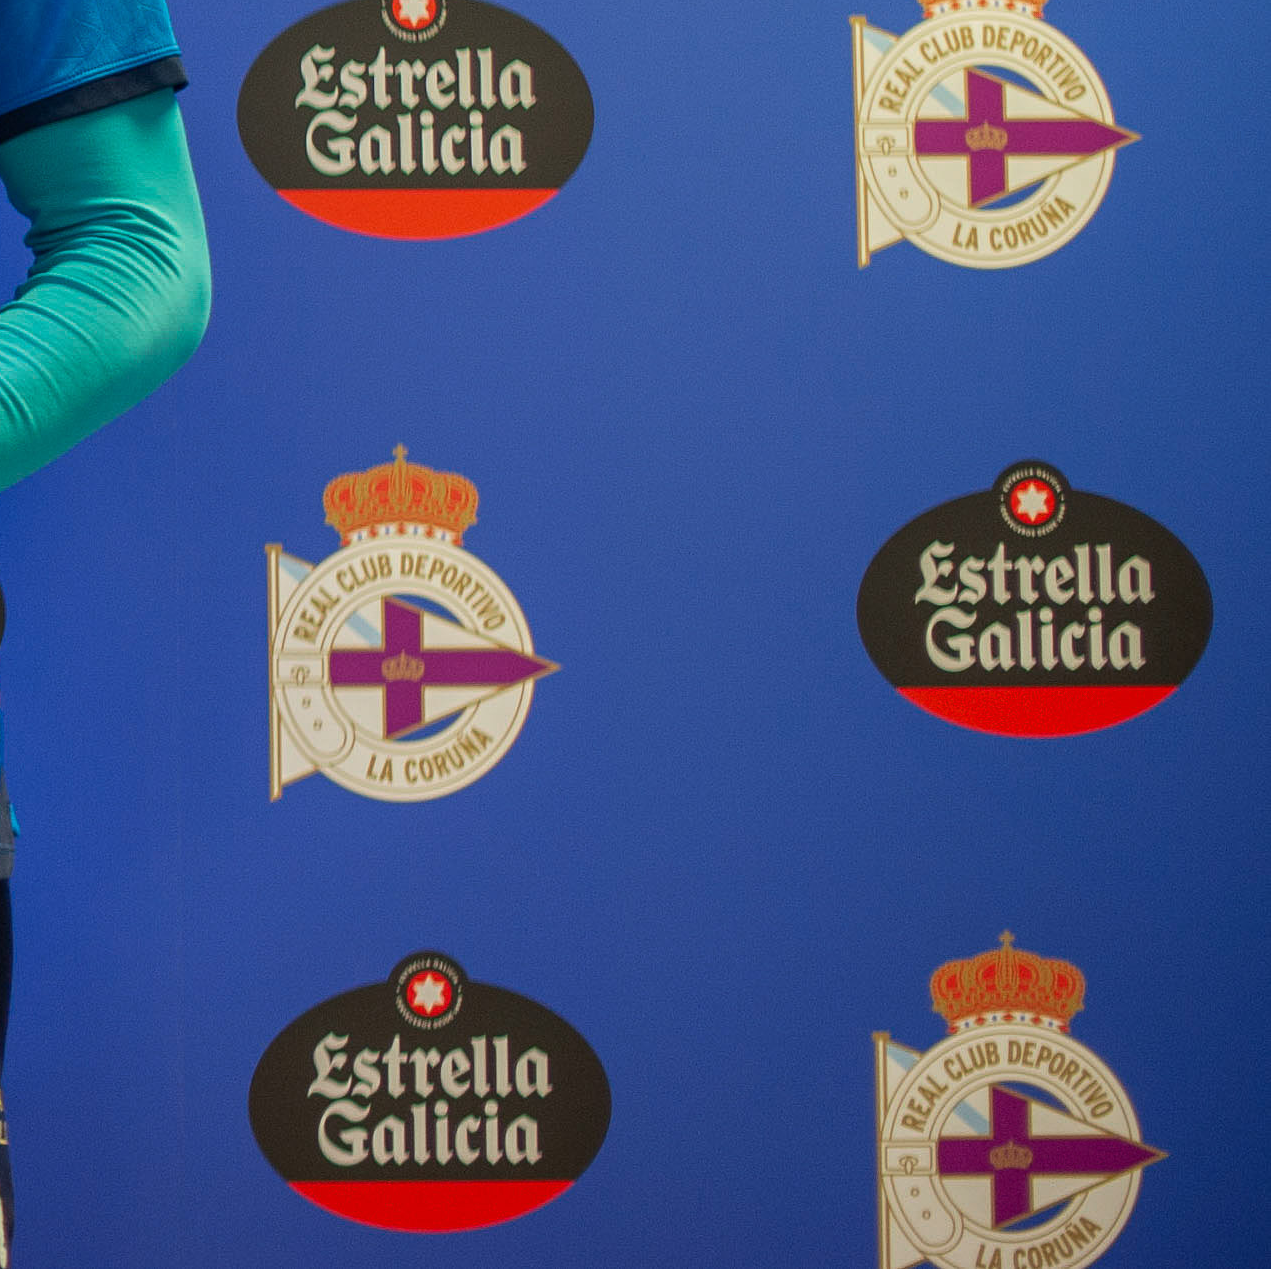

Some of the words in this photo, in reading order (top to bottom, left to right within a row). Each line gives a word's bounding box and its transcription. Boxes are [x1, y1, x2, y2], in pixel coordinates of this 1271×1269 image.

[294, 46, 536, 108] Estrella
[879, 59, 926, 114] REAL
[920, 26, 975, 64] CLUB
[982, 24, 1087, 101] DEPORTIVO
[305, 111, 527, 174] Galicia
[952, 222, 979, 251] LA
[989, 196, 1076, 251] CORUÑA
[294, 587, 342, 643] REAL
[337, 554, 393, 593] CLUB
[401, 552, 506, 631] DEPORTIVO
[913, 542, 1155, 605] Estrella
[924, 608, 1146, 671] Galicia
[366, 754, 394, 784] LA
[404, 727, 494, 784] CORUÑA
[306, 1034, 552, 1098] Estrella
[902, 1076, 950, 1132] REAL
[944, 1041, 1000, 1081] CLUB
[1008, 1039, 1113, 1118] DEPORTIVO
[317, 1101, 543, 1165] Galicia
[974, 1243, 1002, 1269] LA
[1013, 1216, 1102, 1269] CORUÑA
